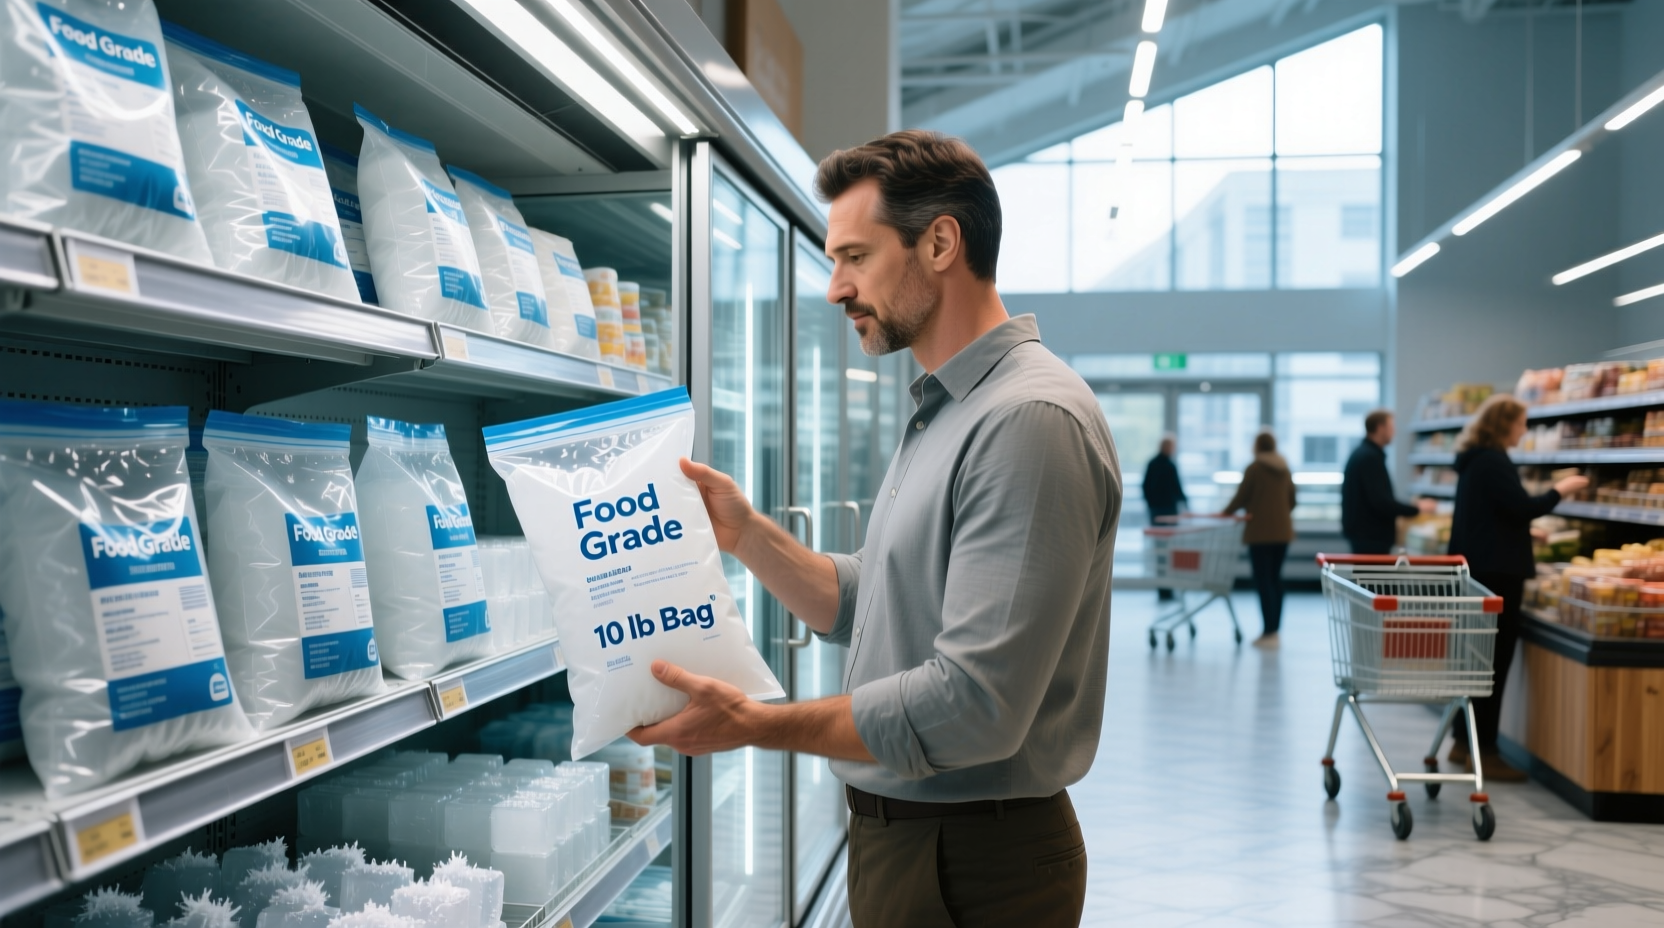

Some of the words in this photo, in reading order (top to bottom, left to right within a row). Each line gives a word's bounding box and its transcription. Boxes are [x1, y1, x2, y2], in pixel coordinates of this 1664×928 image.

[50, 15, 98, 51] Food
[99, 35, 156, 68] Grade
[573, 483, 660, 530] Food
[91, 533, 139, 558] Food
[138, 534, 191, 556] Grade
[580, 515, 683, 560] Grade
[593, 621, 624, 648] 10
[627, 613, 655, 640] lb
[659, 603, 715, 632] Bag
